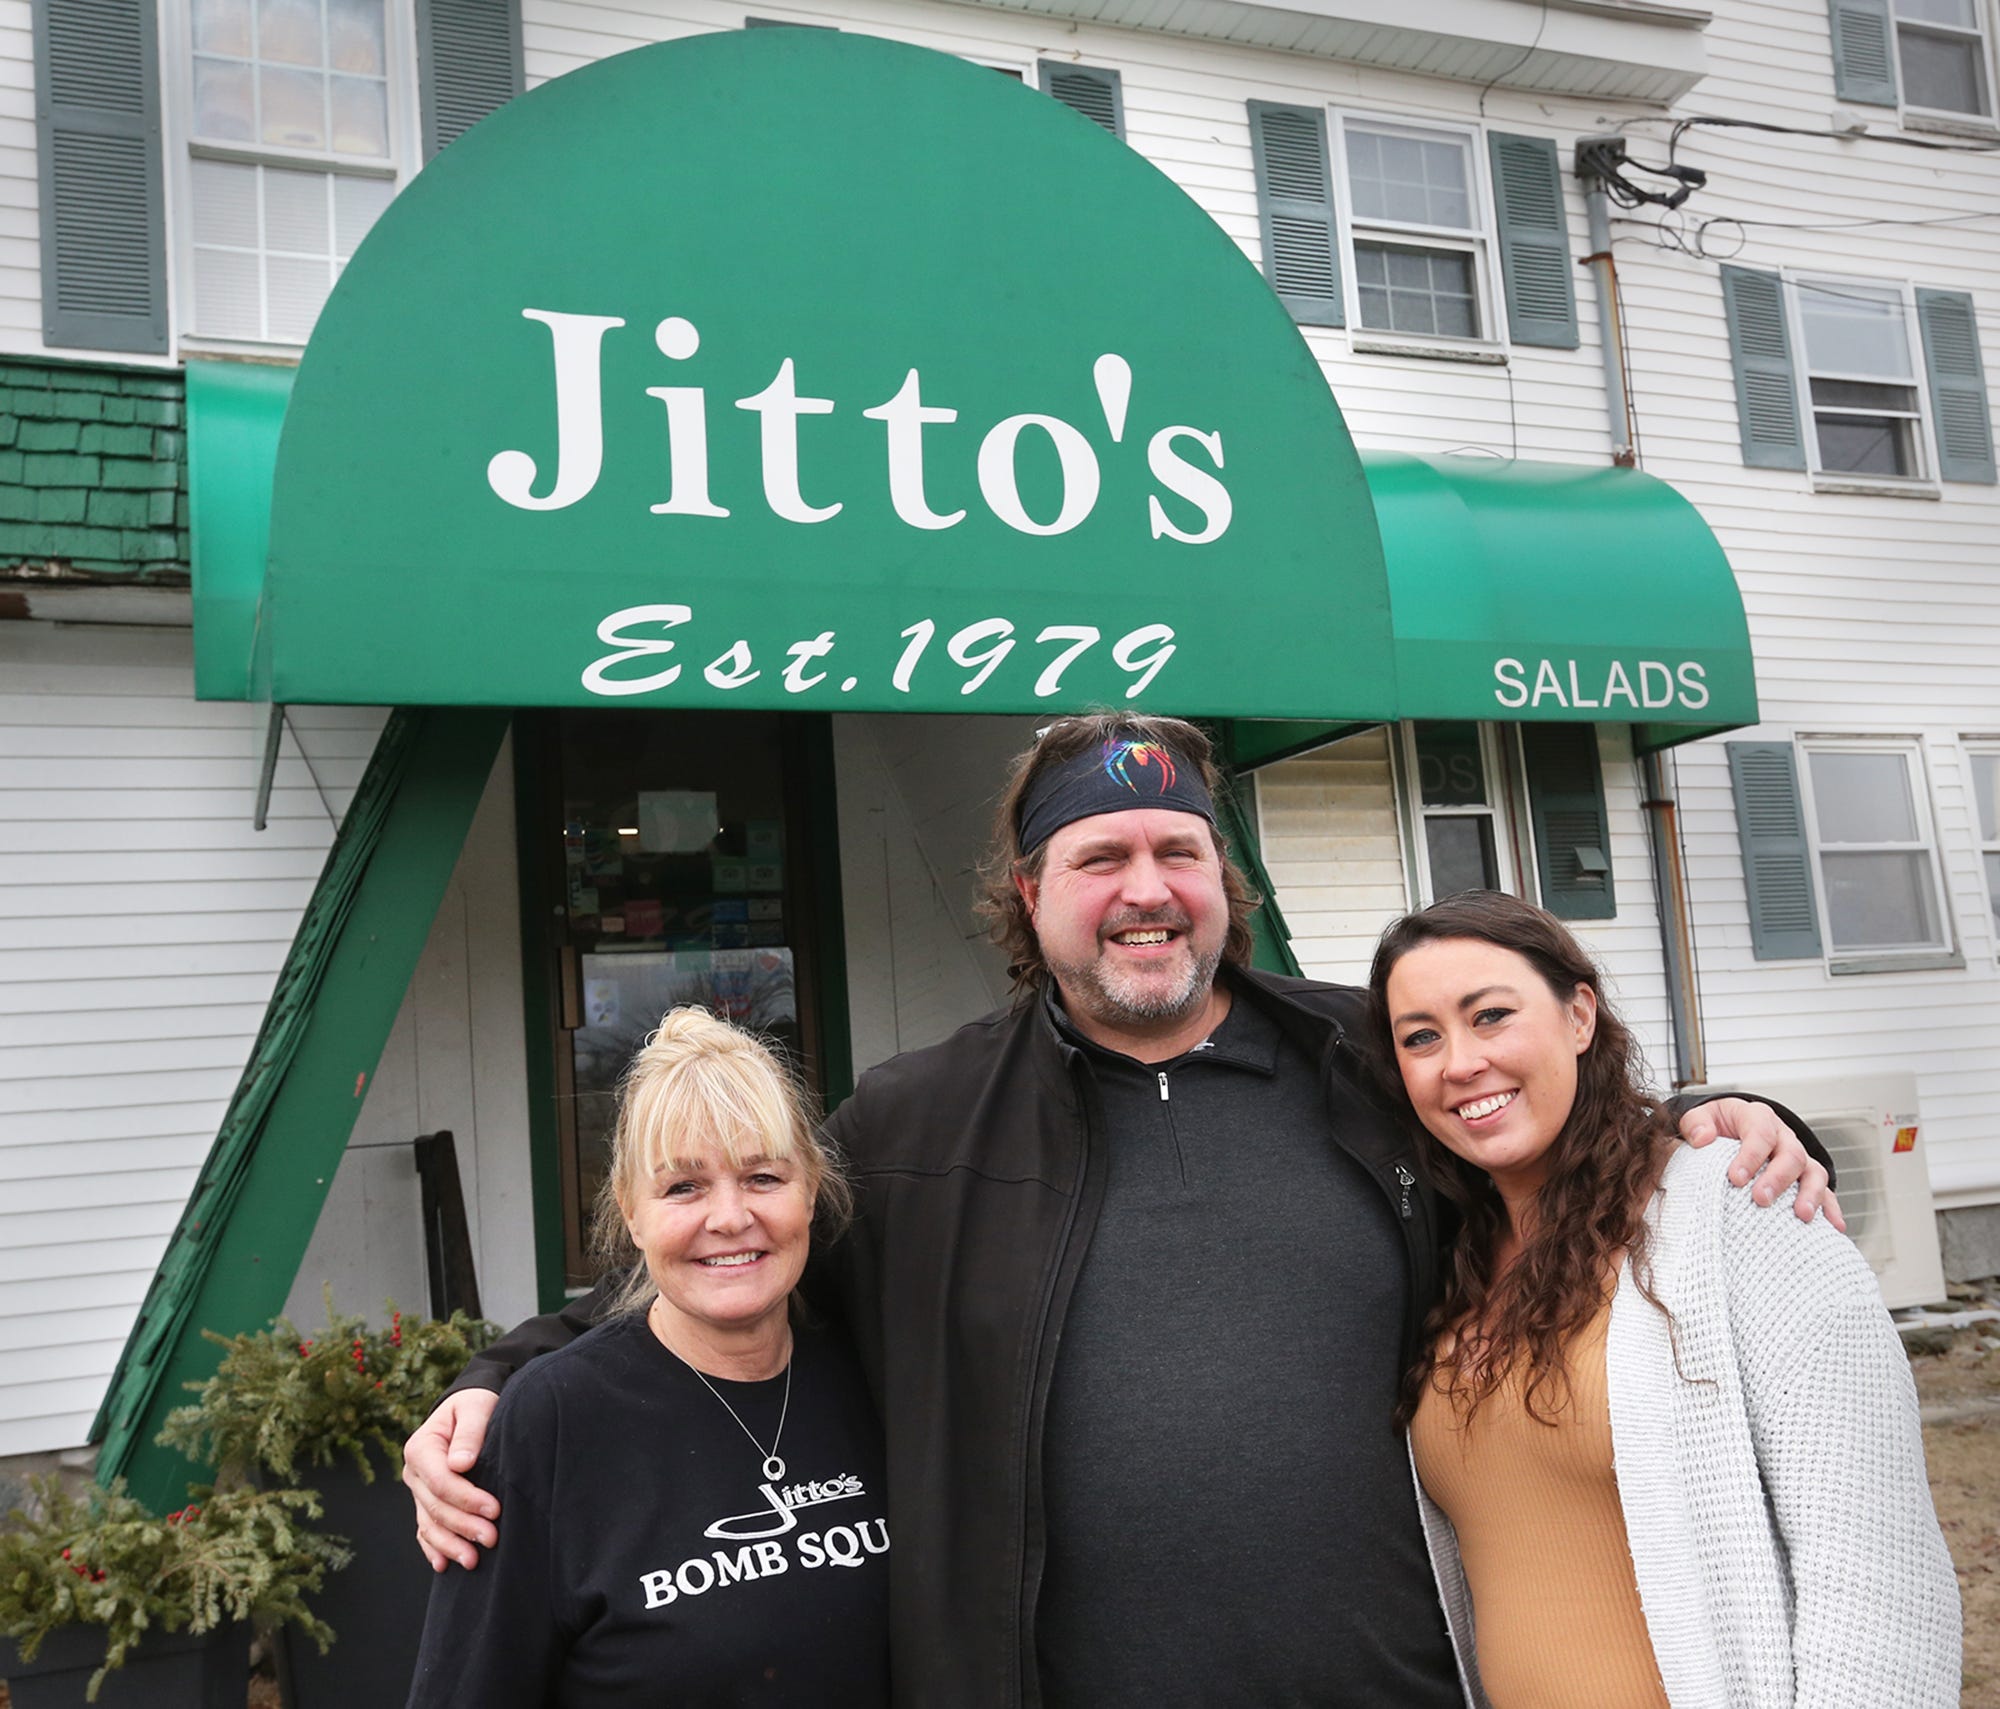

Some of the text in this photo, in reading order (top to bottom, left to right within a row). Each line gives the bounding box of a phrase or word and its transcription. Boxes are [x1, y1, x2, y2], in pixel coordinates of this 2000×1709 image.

[487, 308, 1232, 544] Jitto's
[1494, 657, 1709, 710] SALADS
[704, 1473, 865, 1540] Jitto's
[639, 1518, 890, 1610] BOMB SQU
